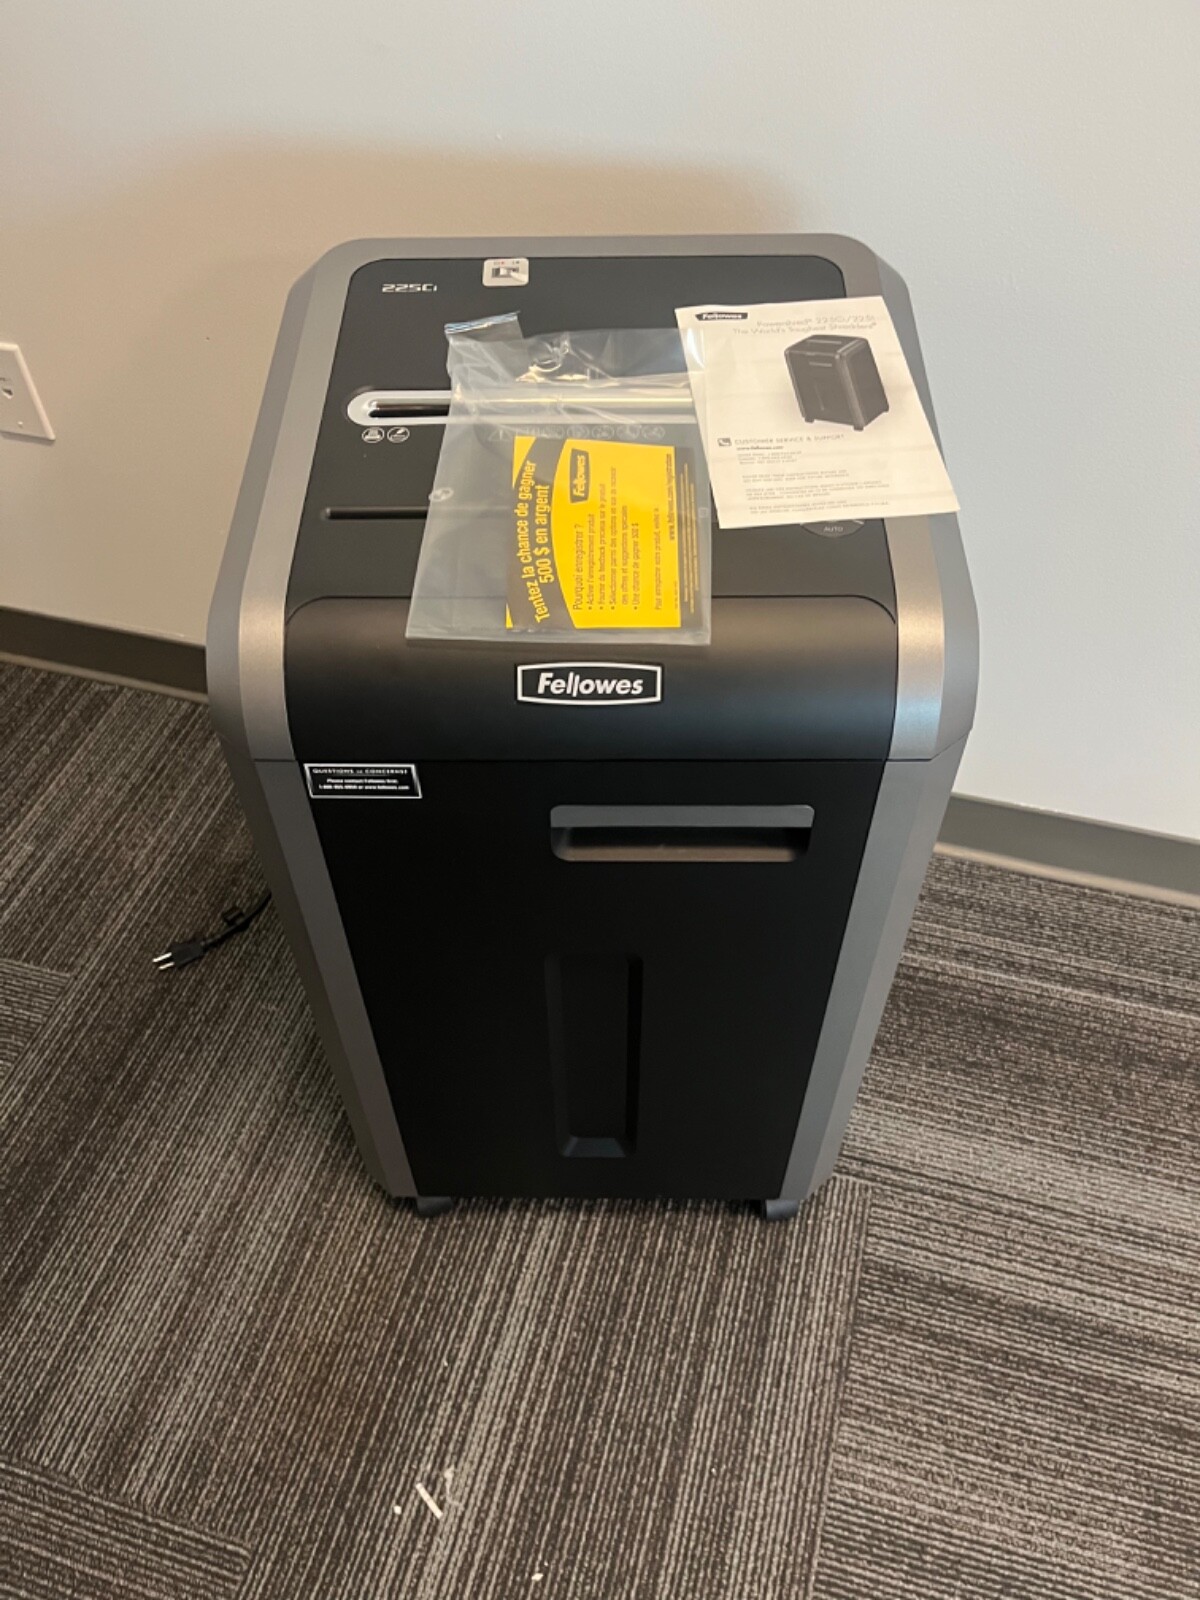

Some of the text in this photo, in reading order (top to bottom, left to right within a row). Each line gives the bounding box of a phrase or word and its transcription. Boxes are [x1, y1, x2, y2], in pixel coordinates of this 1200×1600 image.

[382, 283, 438, 293] 225Ci
[702, 313, 743, 321] Fellowes
[572, 454, 587, 498] Fellowes
[514, 460, 550, 623] Tentez la chance de gagner
[533, 484, 554, 585] 500 $ en argent
[573, 574, 584, 610] Pourquoi
[537, 672, 643, 697] Fellowes
